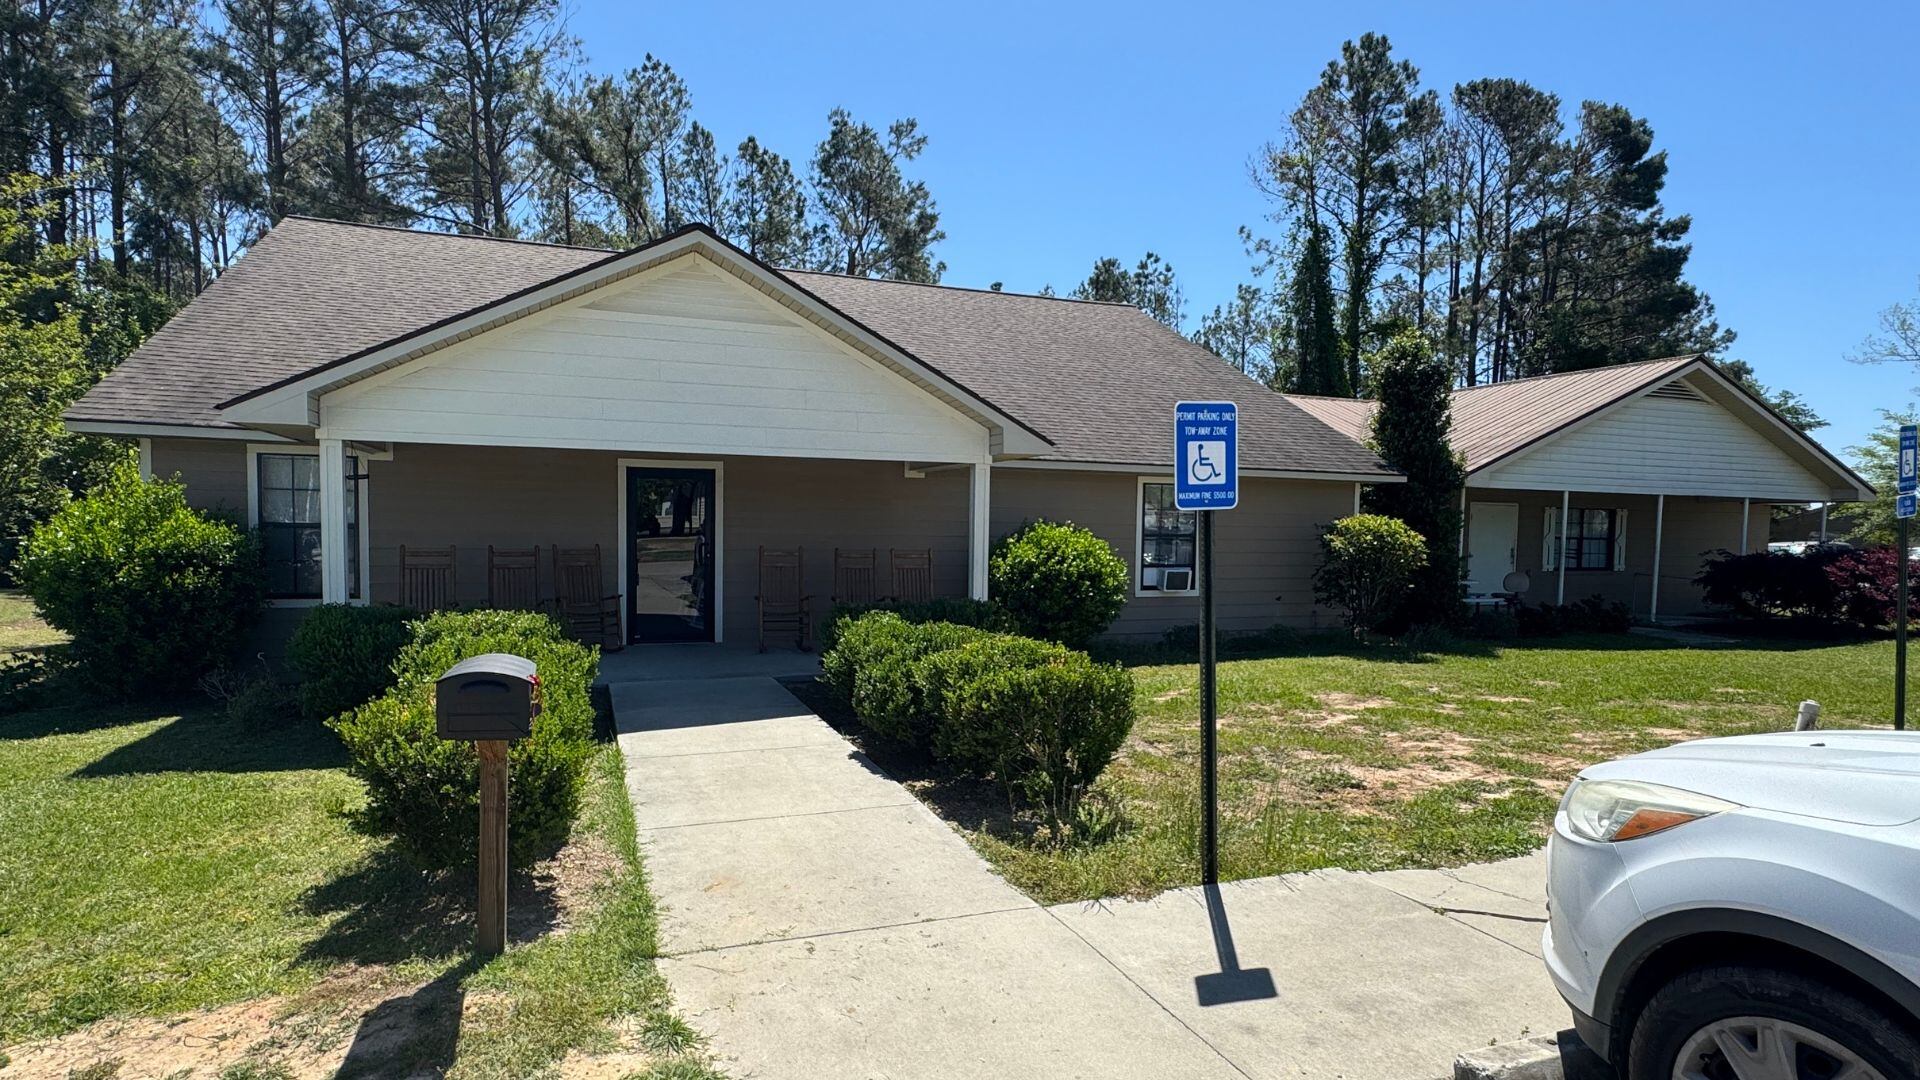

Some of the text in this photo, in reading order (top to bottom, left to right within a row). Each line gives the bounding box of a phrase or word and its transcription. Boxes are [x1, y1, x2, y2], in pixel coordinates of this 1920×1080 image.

[1176, 412, 1235, 421] PERMIT PARKING ONLY
[1184, 426, 1227, 435] TOW-AWAY ZONE
